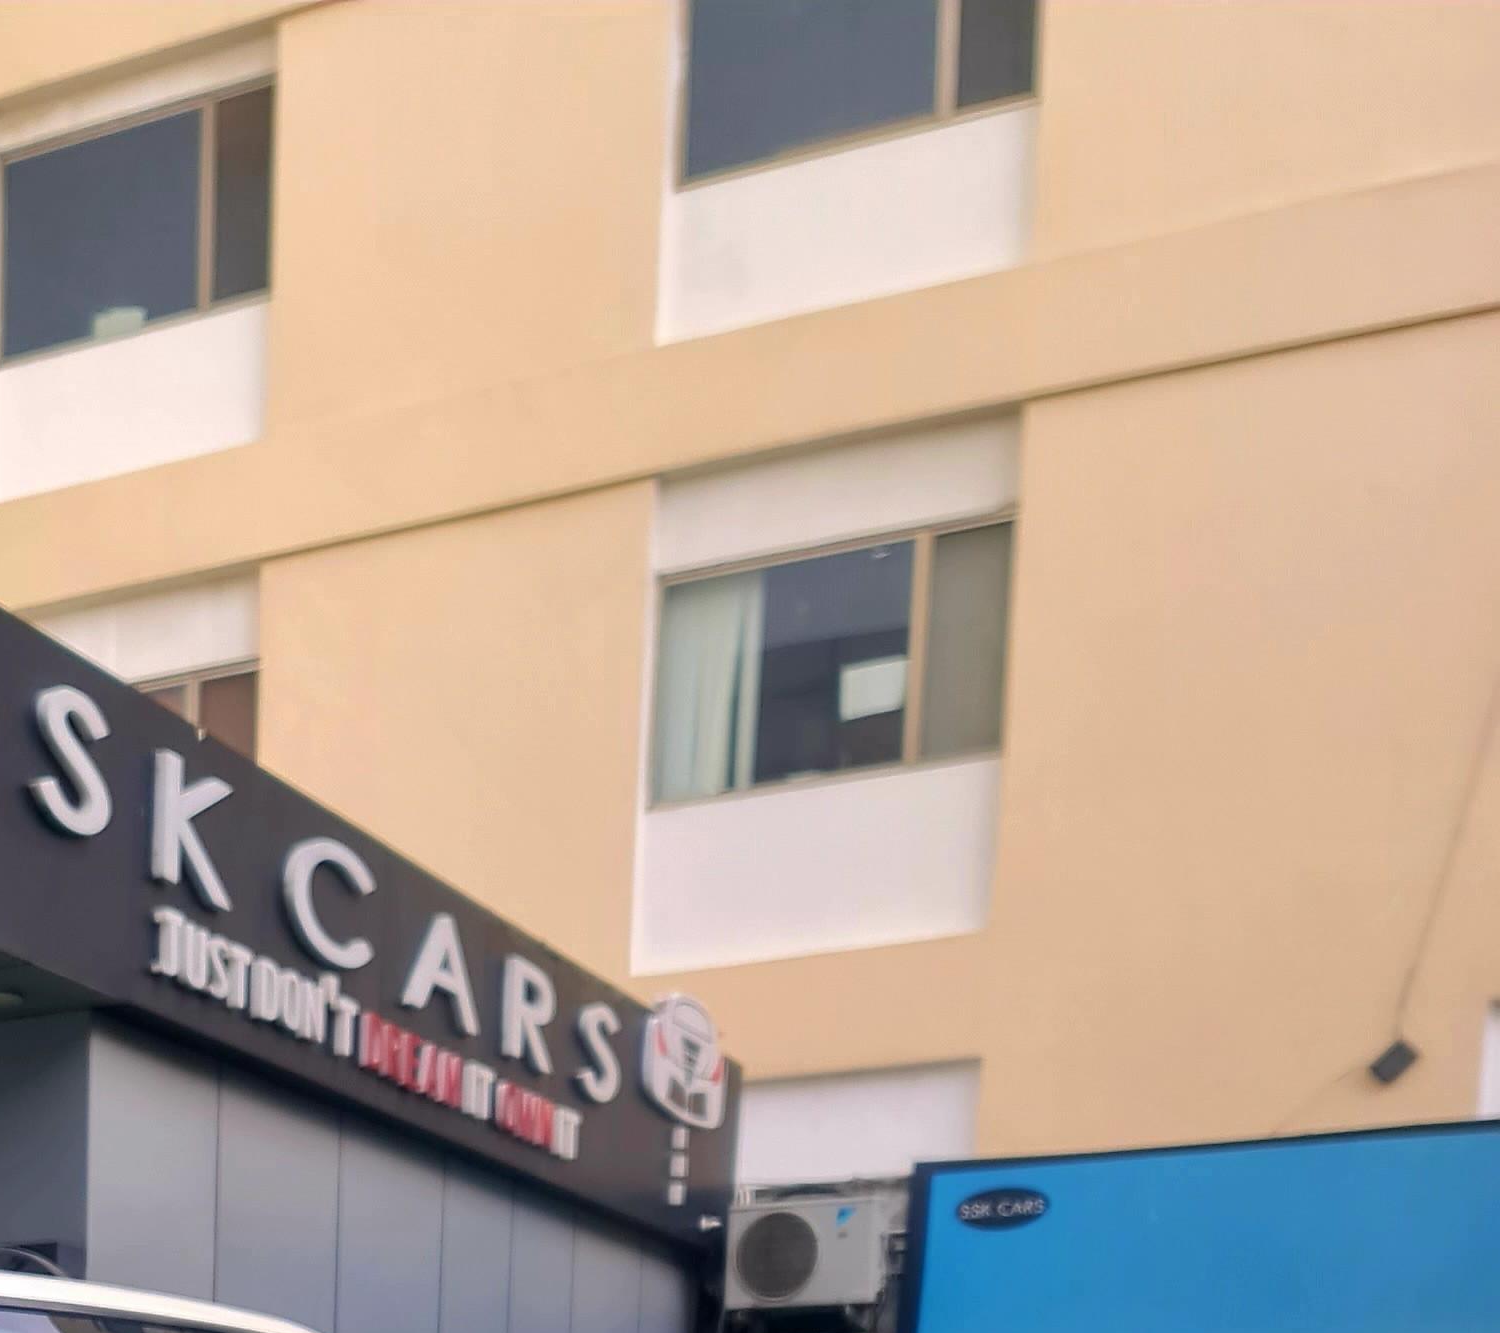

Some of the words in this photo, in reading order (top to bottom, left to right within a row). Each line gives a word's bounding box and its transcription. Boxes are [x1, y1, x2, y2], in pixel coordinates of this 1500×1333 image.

[150, 905, 253, 1009] JUST
[250, 955, 360, 1057] DON'T
[461, 1058, 497, 1120] IT
[551, 1104, 583, 1161] IT
[959, 1203, 990, 1219] SSK
[997, 1199, 1045, 1217] CARS
